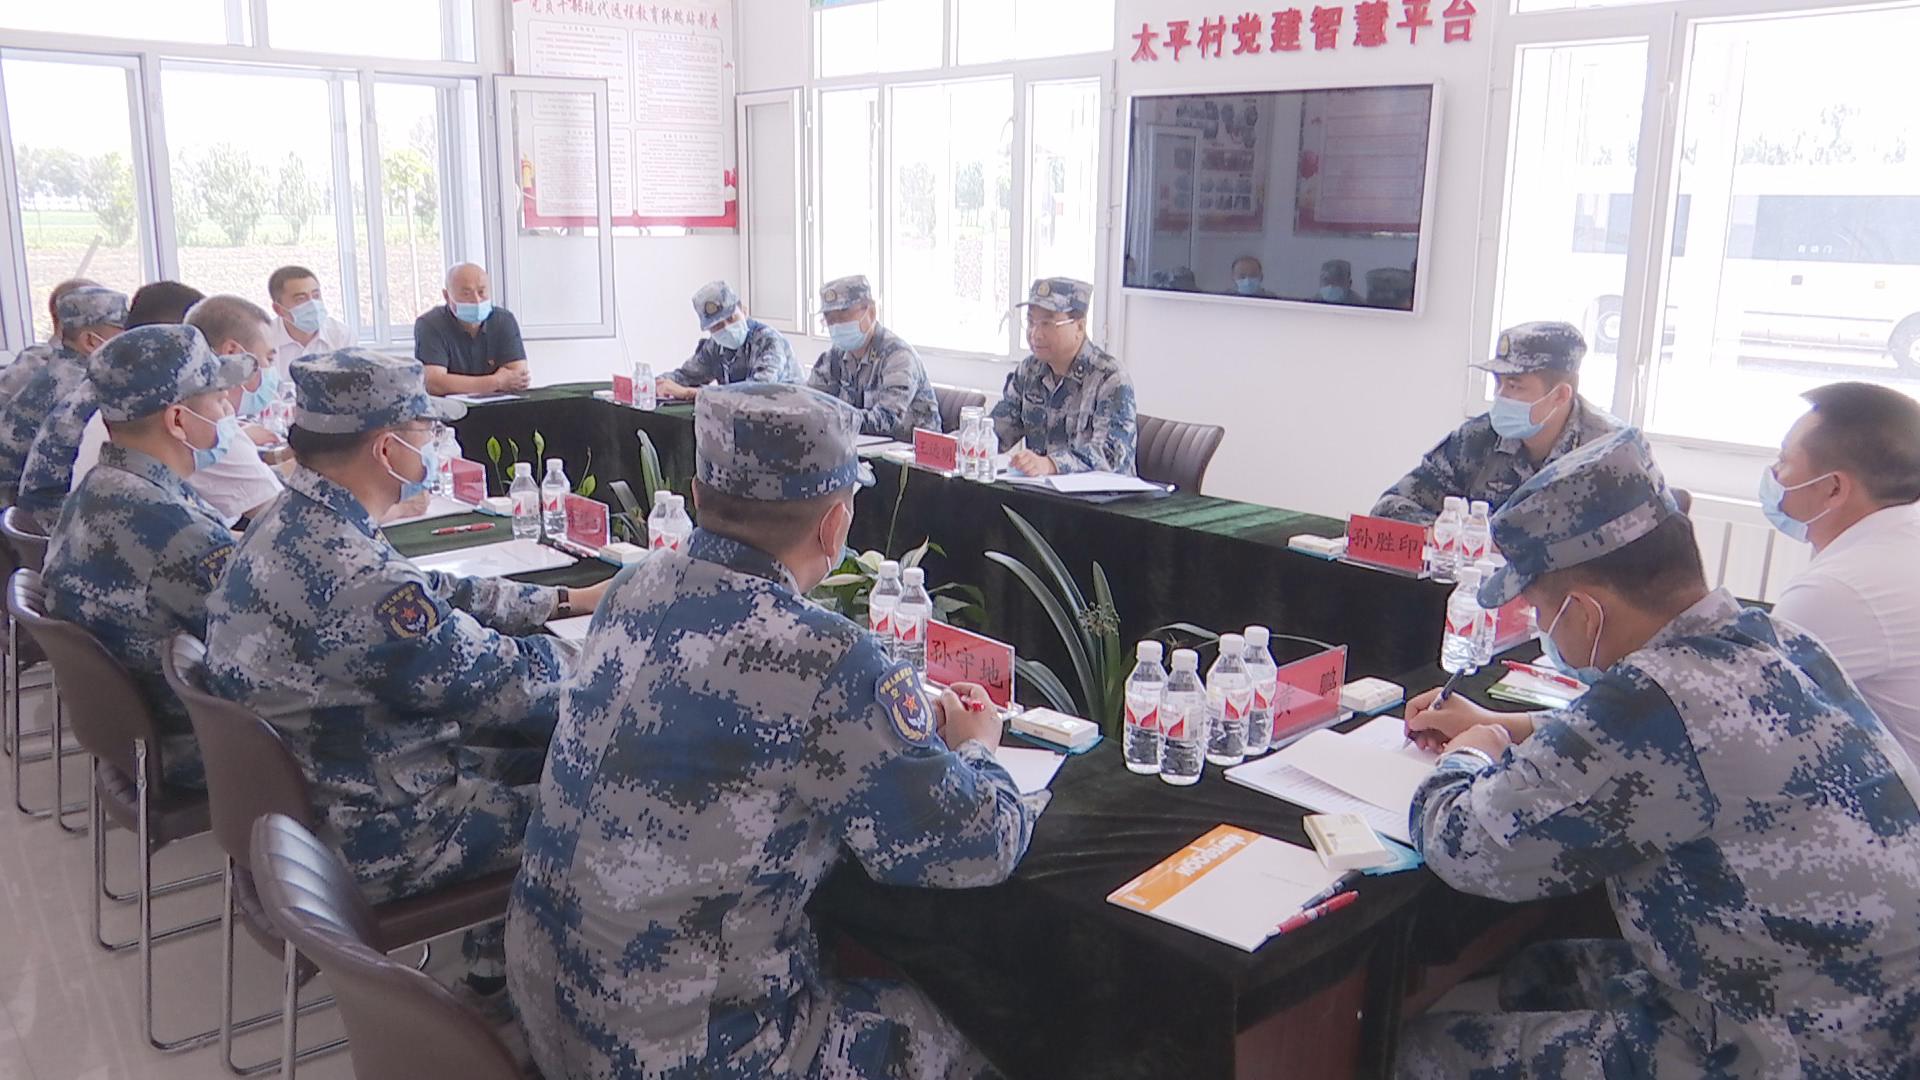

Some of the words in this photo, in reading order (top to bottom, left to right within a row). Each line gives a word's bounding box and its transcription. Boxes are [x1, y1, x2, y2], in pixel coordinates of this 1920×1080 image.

[1130, 0, 1478, 62] 太平村党建智慧平台
[1351, 527, 1418, 559] 孙胜印
